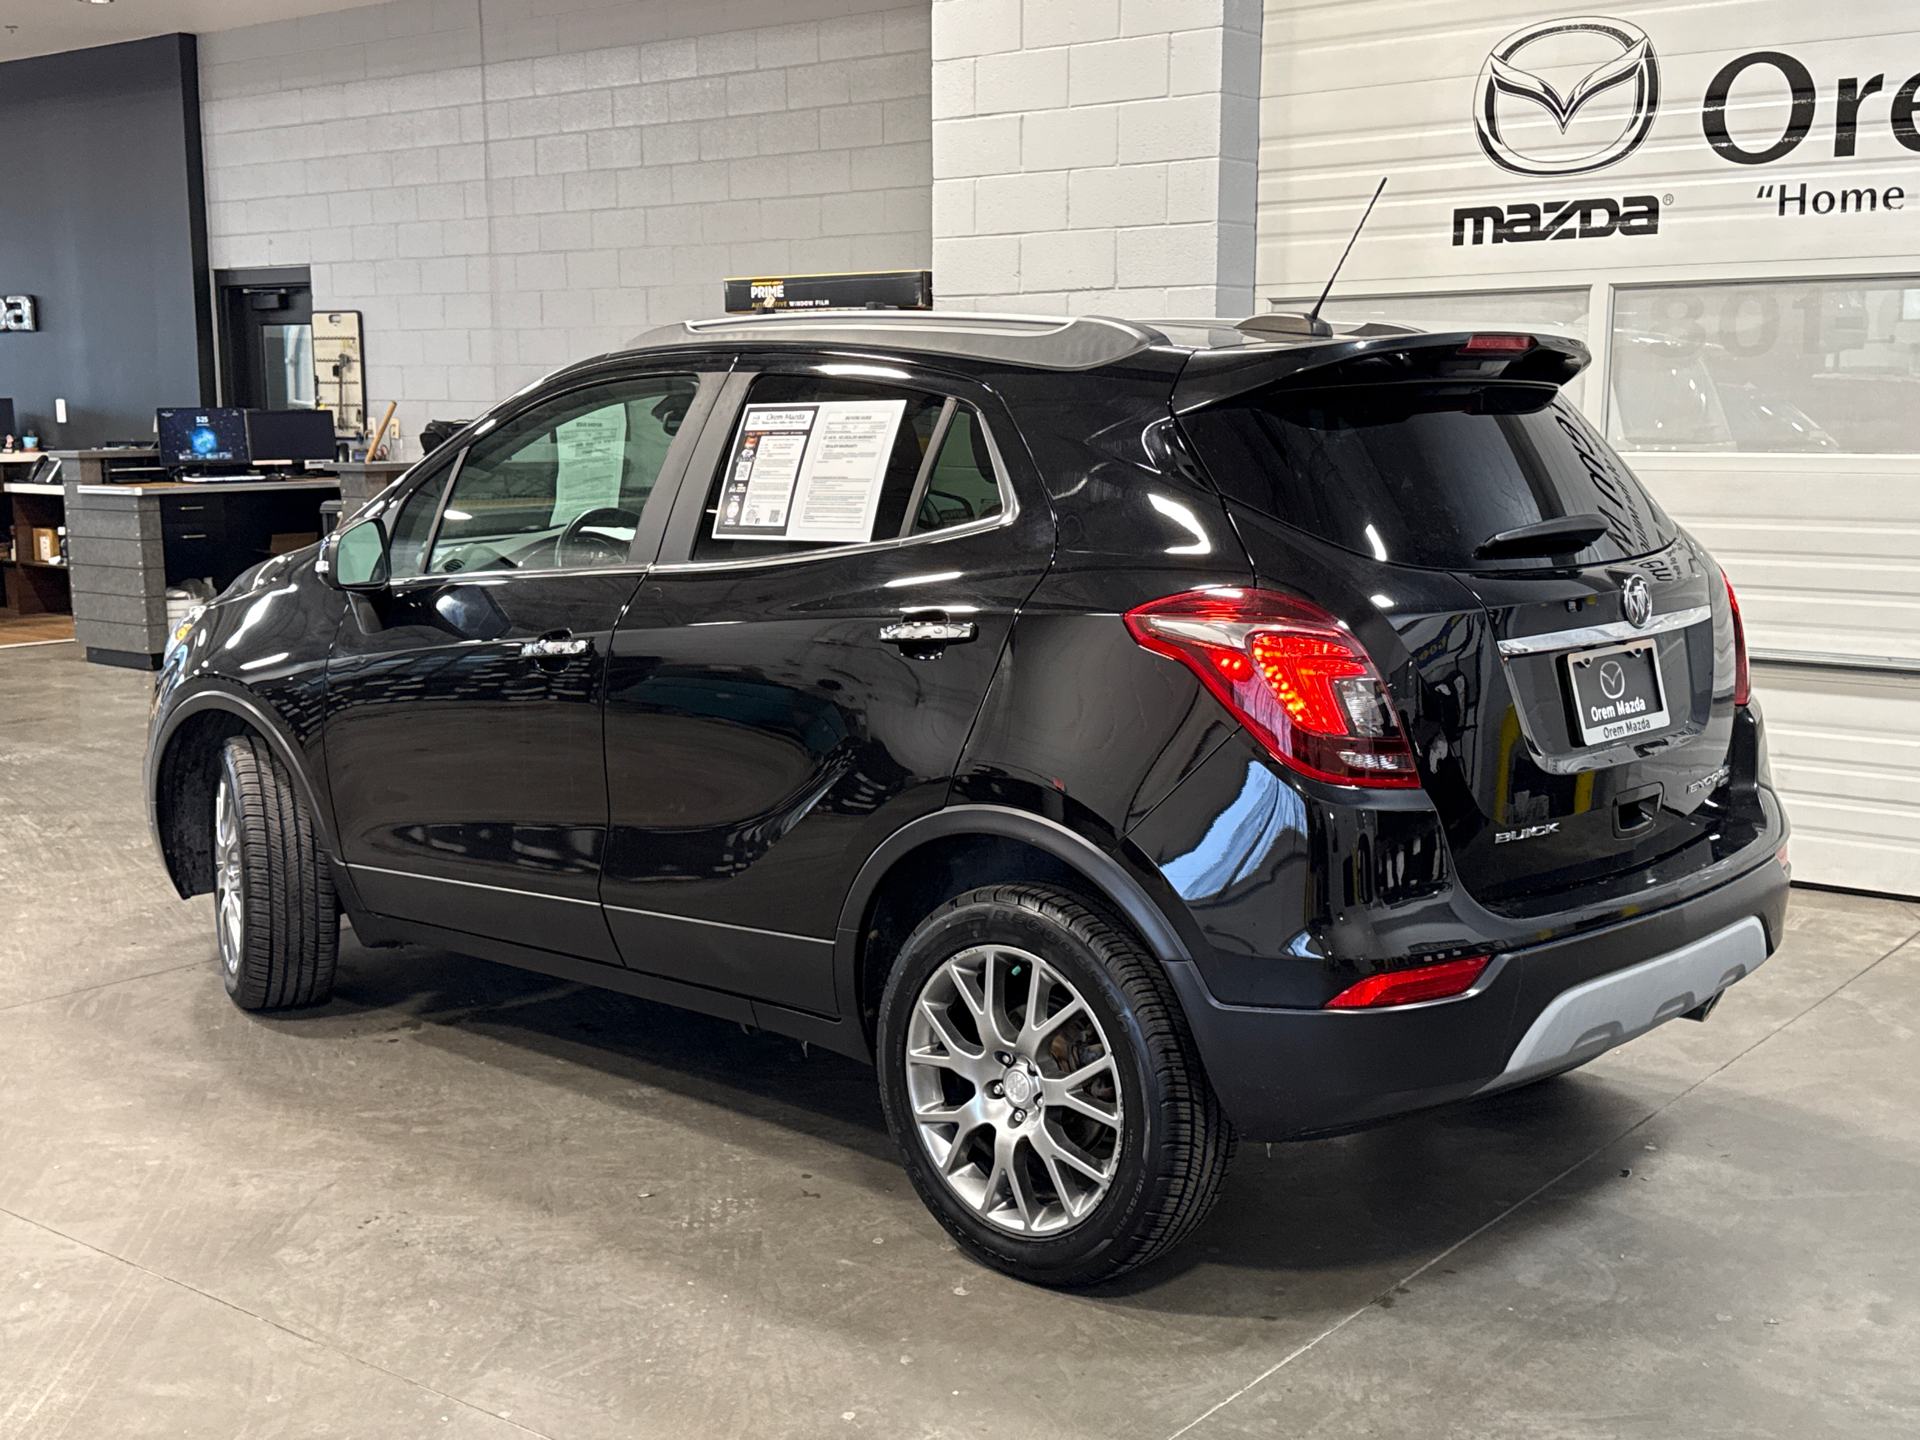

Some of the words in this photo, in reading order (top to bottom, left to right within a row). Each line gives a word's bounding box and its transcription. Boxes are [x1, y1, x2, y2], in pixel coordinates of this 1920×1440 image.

[750, 285, 785, 299] PRIME
[1590, 704, 1616, 722] Orem
[1616, 696, 1646, 717] Mazda
[1603, 726, 1625, 739] Orem
[1625, 717, 1651, 733] Mazda
[1494, 822, 1560, 844] BUICK
